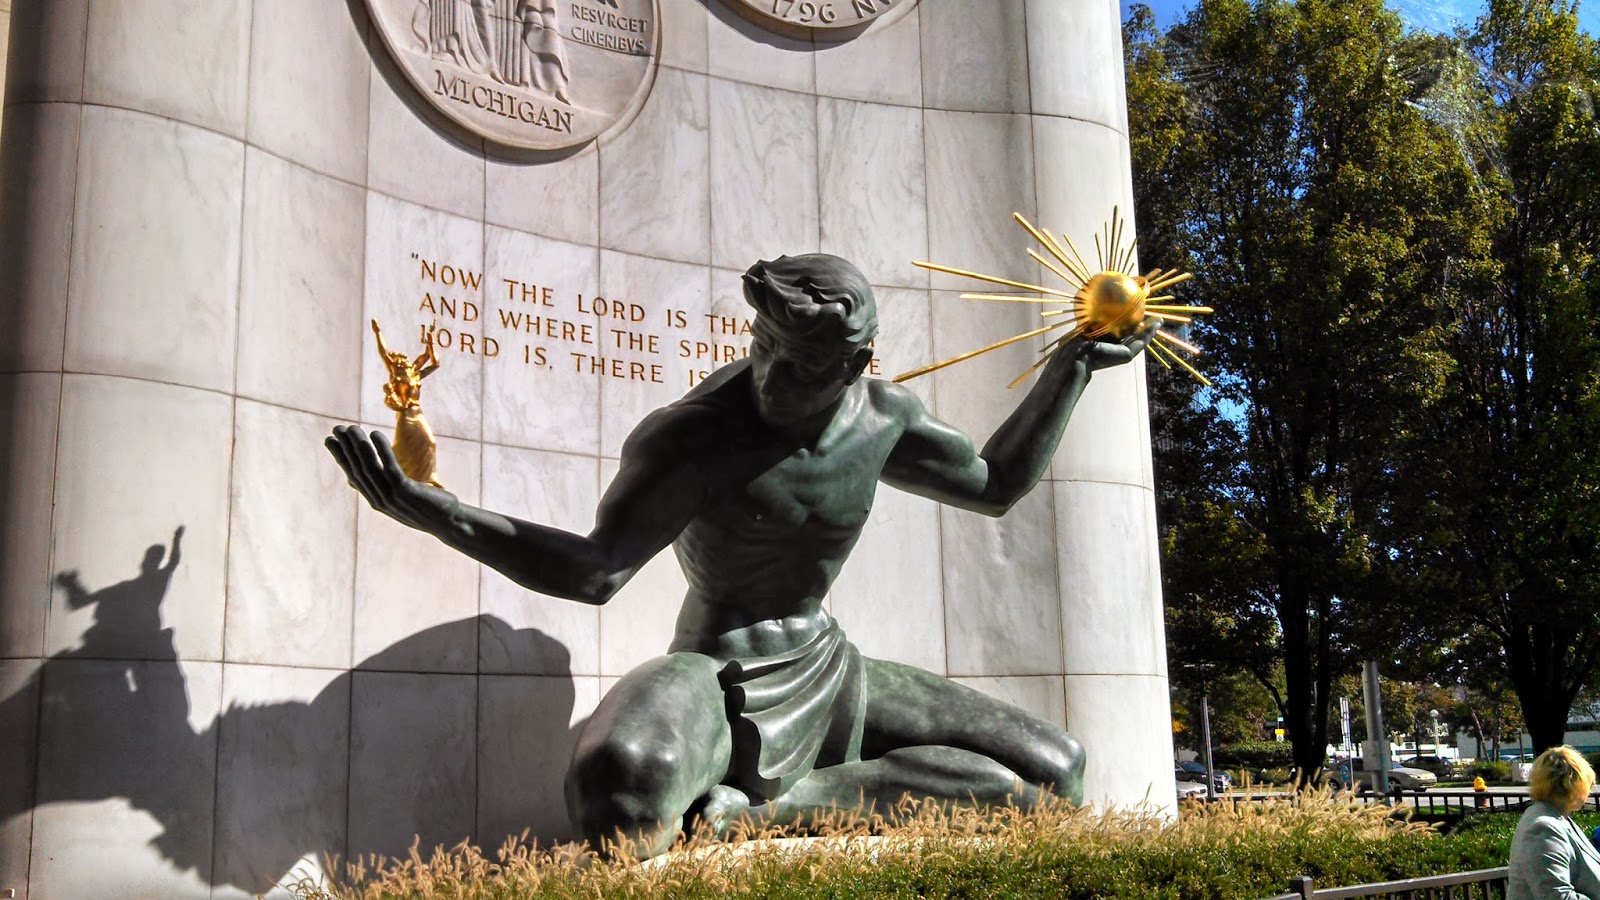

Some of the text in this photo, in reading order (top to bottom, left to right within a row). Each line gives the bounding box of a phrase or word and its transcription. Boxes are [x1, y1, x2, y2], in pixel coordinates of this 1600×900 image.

[571, 26, 646, 52] CINERIBVS
[434, 69, 575, 134] MICHIGAN
[418, 292, 748, 363] AND WHERE THE SPIRI
[503, 278, 555, 308] THE
[577, 293, 646, 322] LORD
[667, 308, 687, 329] IS
[704, 313, 755, 337] THA
[420, 324, 500, 358] LORD
[524, 344, 553, 371] IS,
[570, 352, 664, 384] THERE
